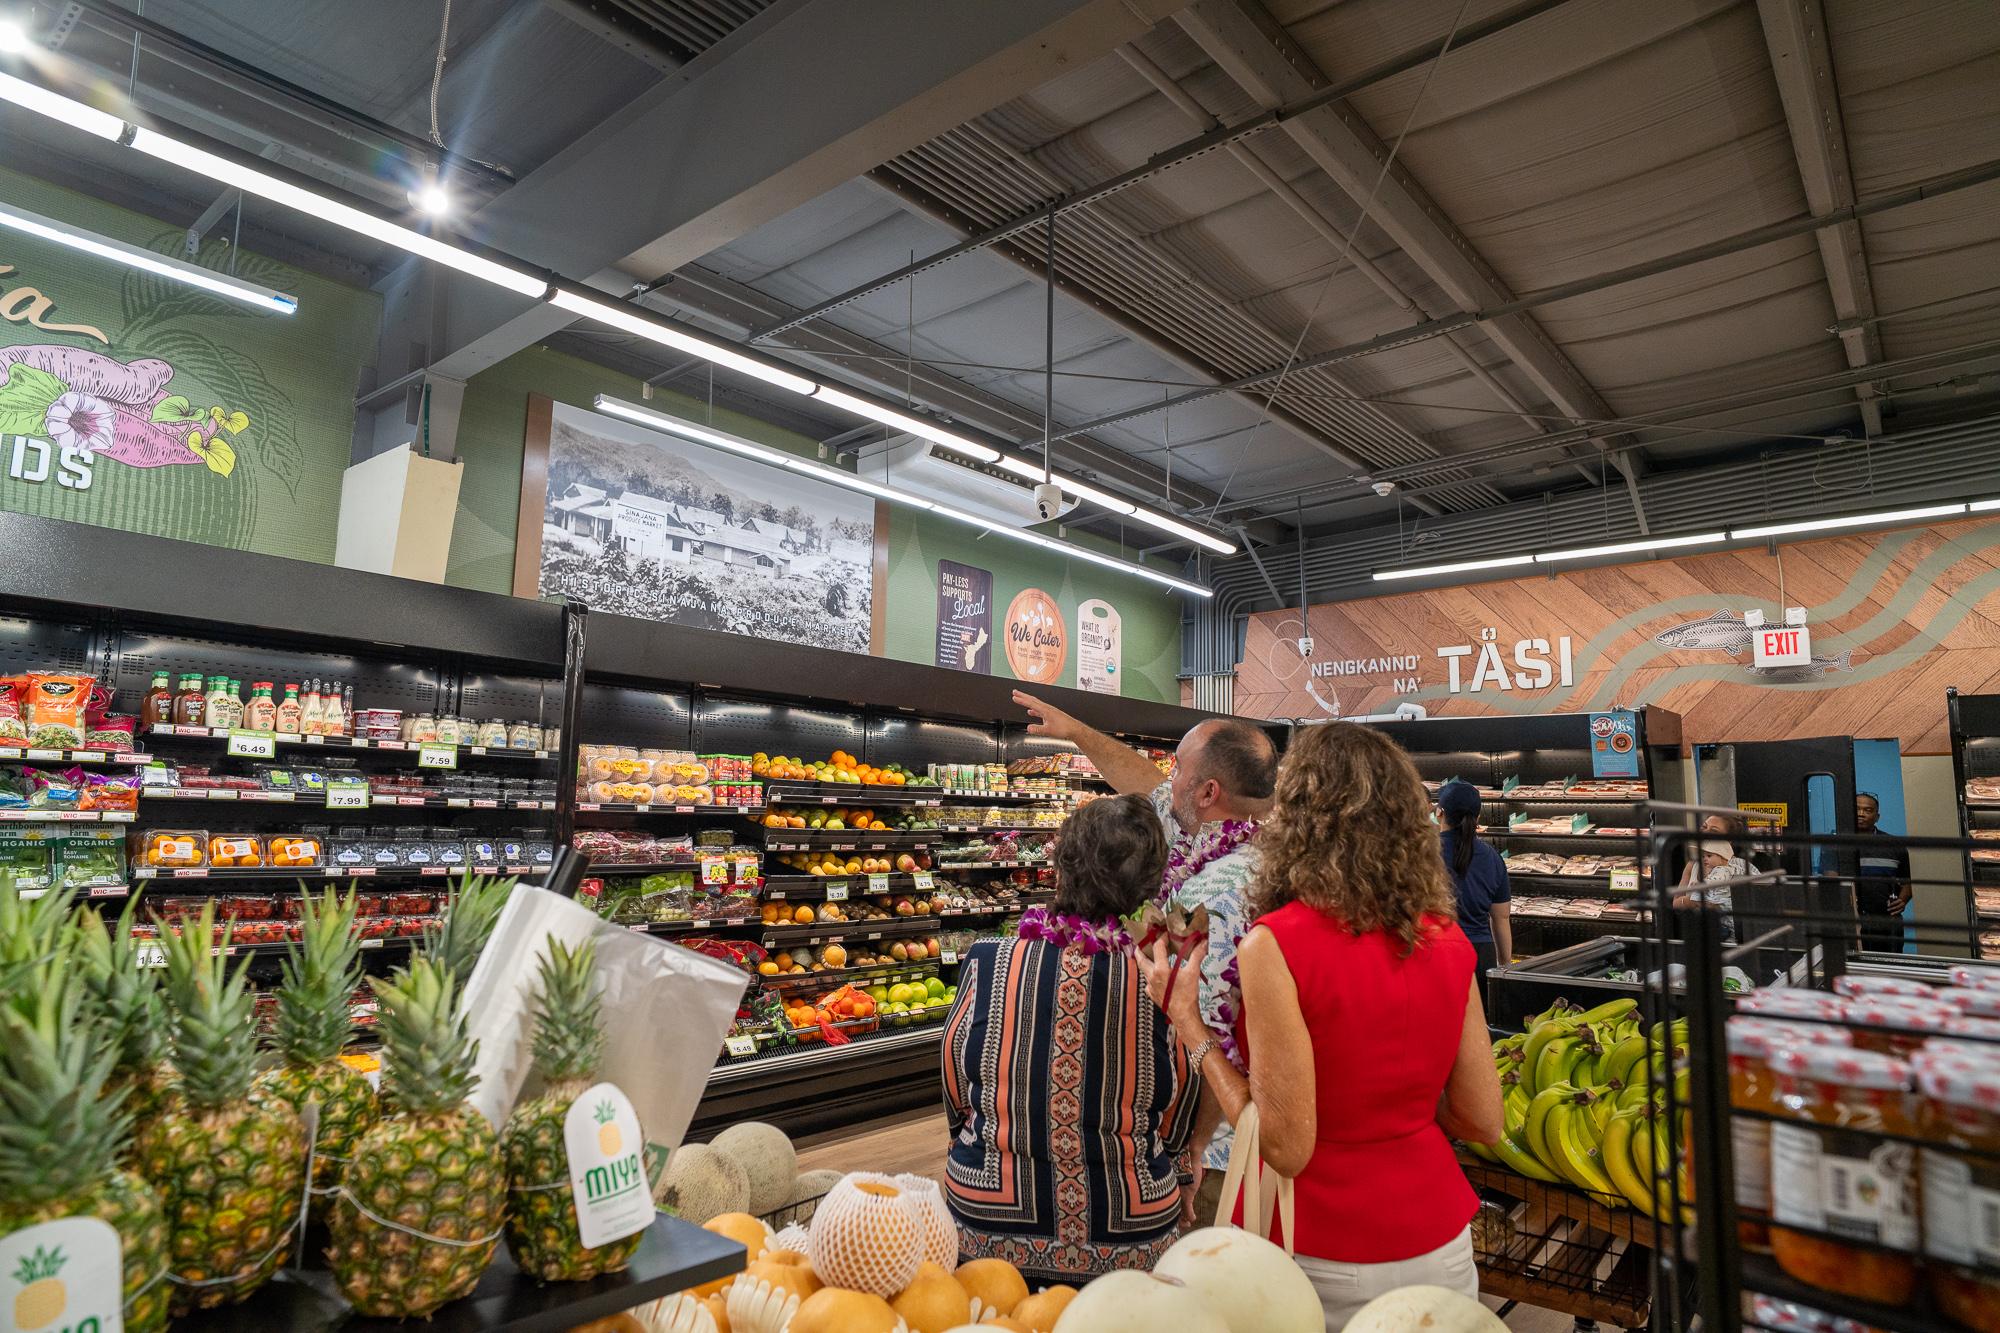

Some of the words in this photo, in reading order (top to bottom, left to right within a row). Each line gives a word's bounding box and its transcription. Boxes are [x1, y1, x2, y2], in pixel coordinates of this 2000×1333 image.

[0, 432, 95, 490] DS
[942, 572, 969, 589] PAY-LESS
[942, 585, 973, 602] SUPPORTS
[560, 574, 641, 599] HISTORIC
[736, 607, 797, 627] PRODUCE
[805, 620, 855, 638] MARKET
[951, 594, 985, 620] Local
[1010, 622, 1032, 643] We
[1033, 628, 1061, 648] Cater
[1081, 621, 1094, 632] WHAT
[1094, 623, 1100, 634] IS
[1080, 632, 1103, 647] ORGANIC?
[1763, 631, 1800, 657] EXIT
[1393, 676, 1422, 693] NA'
[236, 743, 266, 754] $6.49
[425, 756, 450, 765] $7.59
[333, 796, 361, 805] $7.99
[0, 822, 46, 830] arthbound
[69, 822, 115, 830] Earthbound
